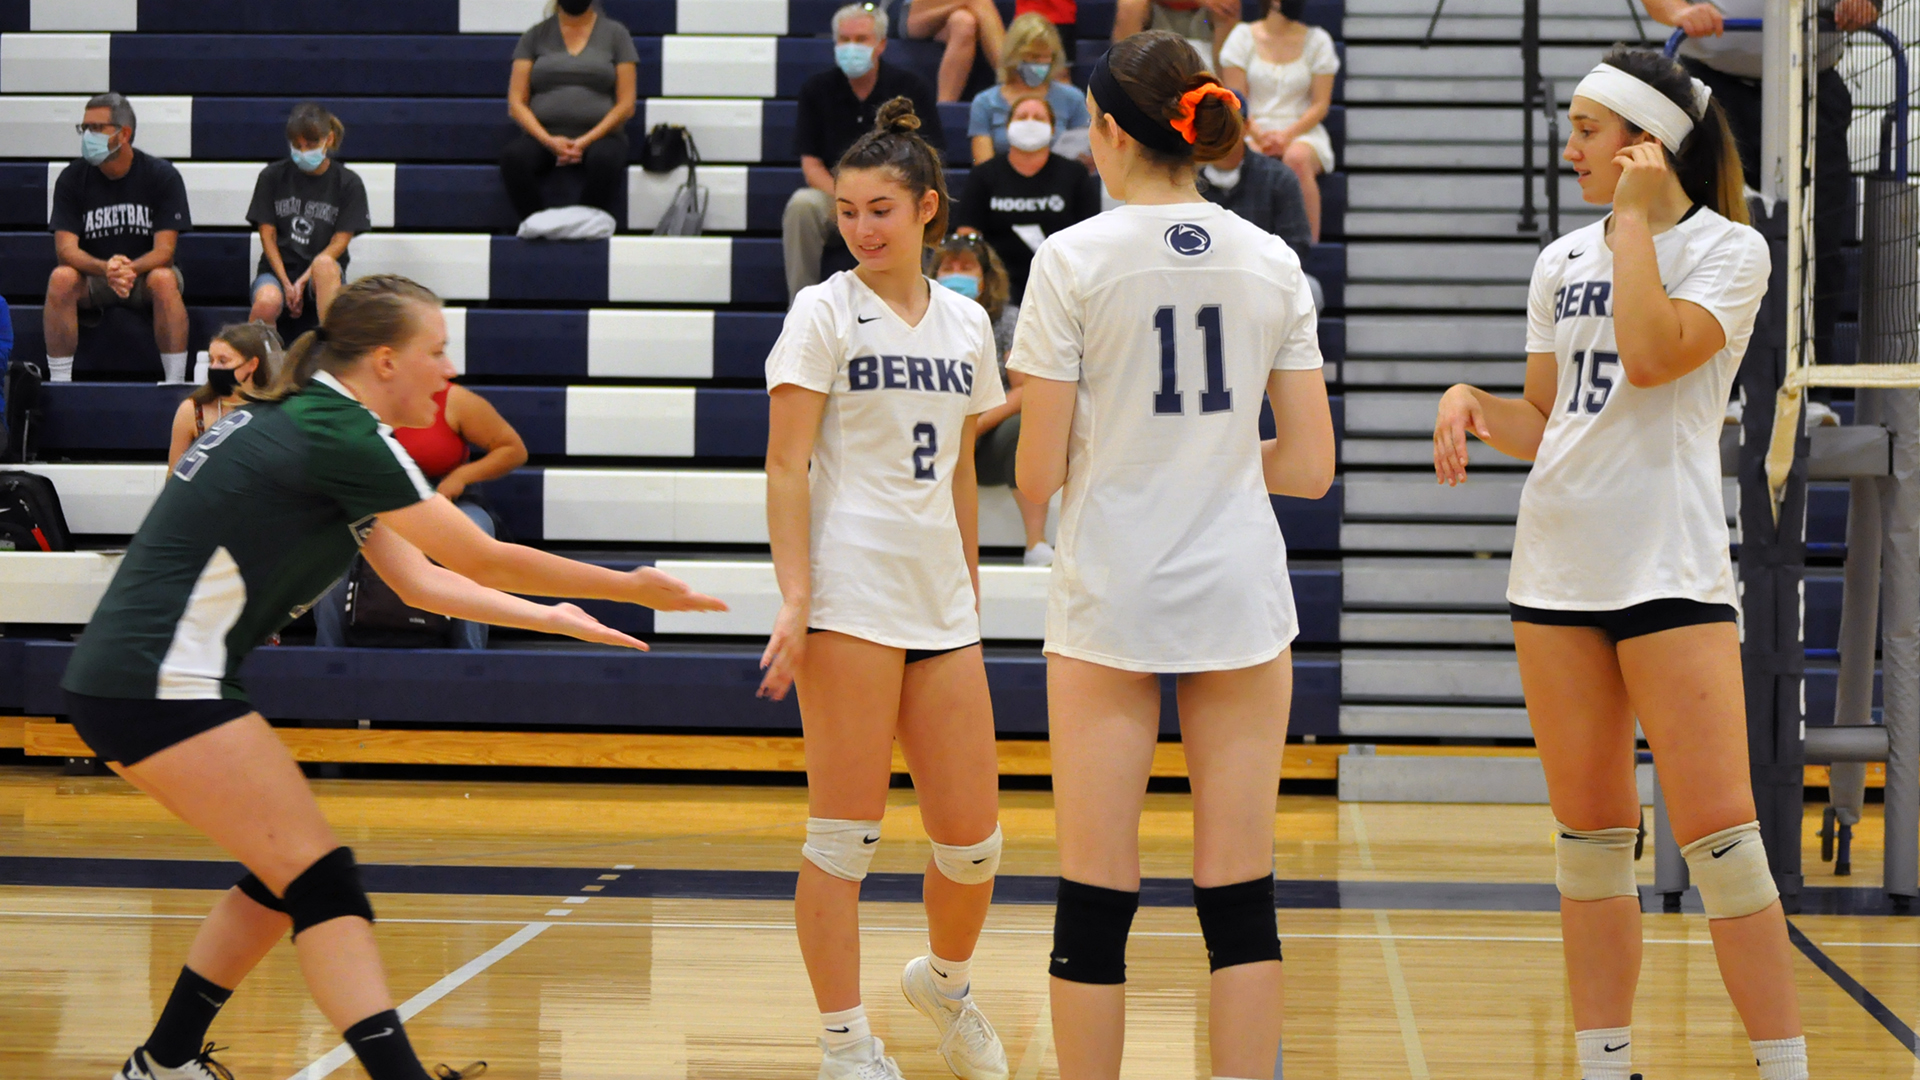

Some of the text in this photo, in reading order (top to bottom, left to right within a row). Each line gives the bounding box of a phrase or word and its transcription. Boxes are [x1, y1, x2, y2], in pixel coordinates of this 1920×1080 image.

[83, 203, 153, 232] ASKETBAL
[129, 226, 153, 237] FAM
[1553, 281, 1614, 326] BER
[847, 355, 973, 398] BERKS
[1152, 304, 1233, 416] 11
[1566, 349, 1618, 415] 15
[912, 421, 938, 481] 2
